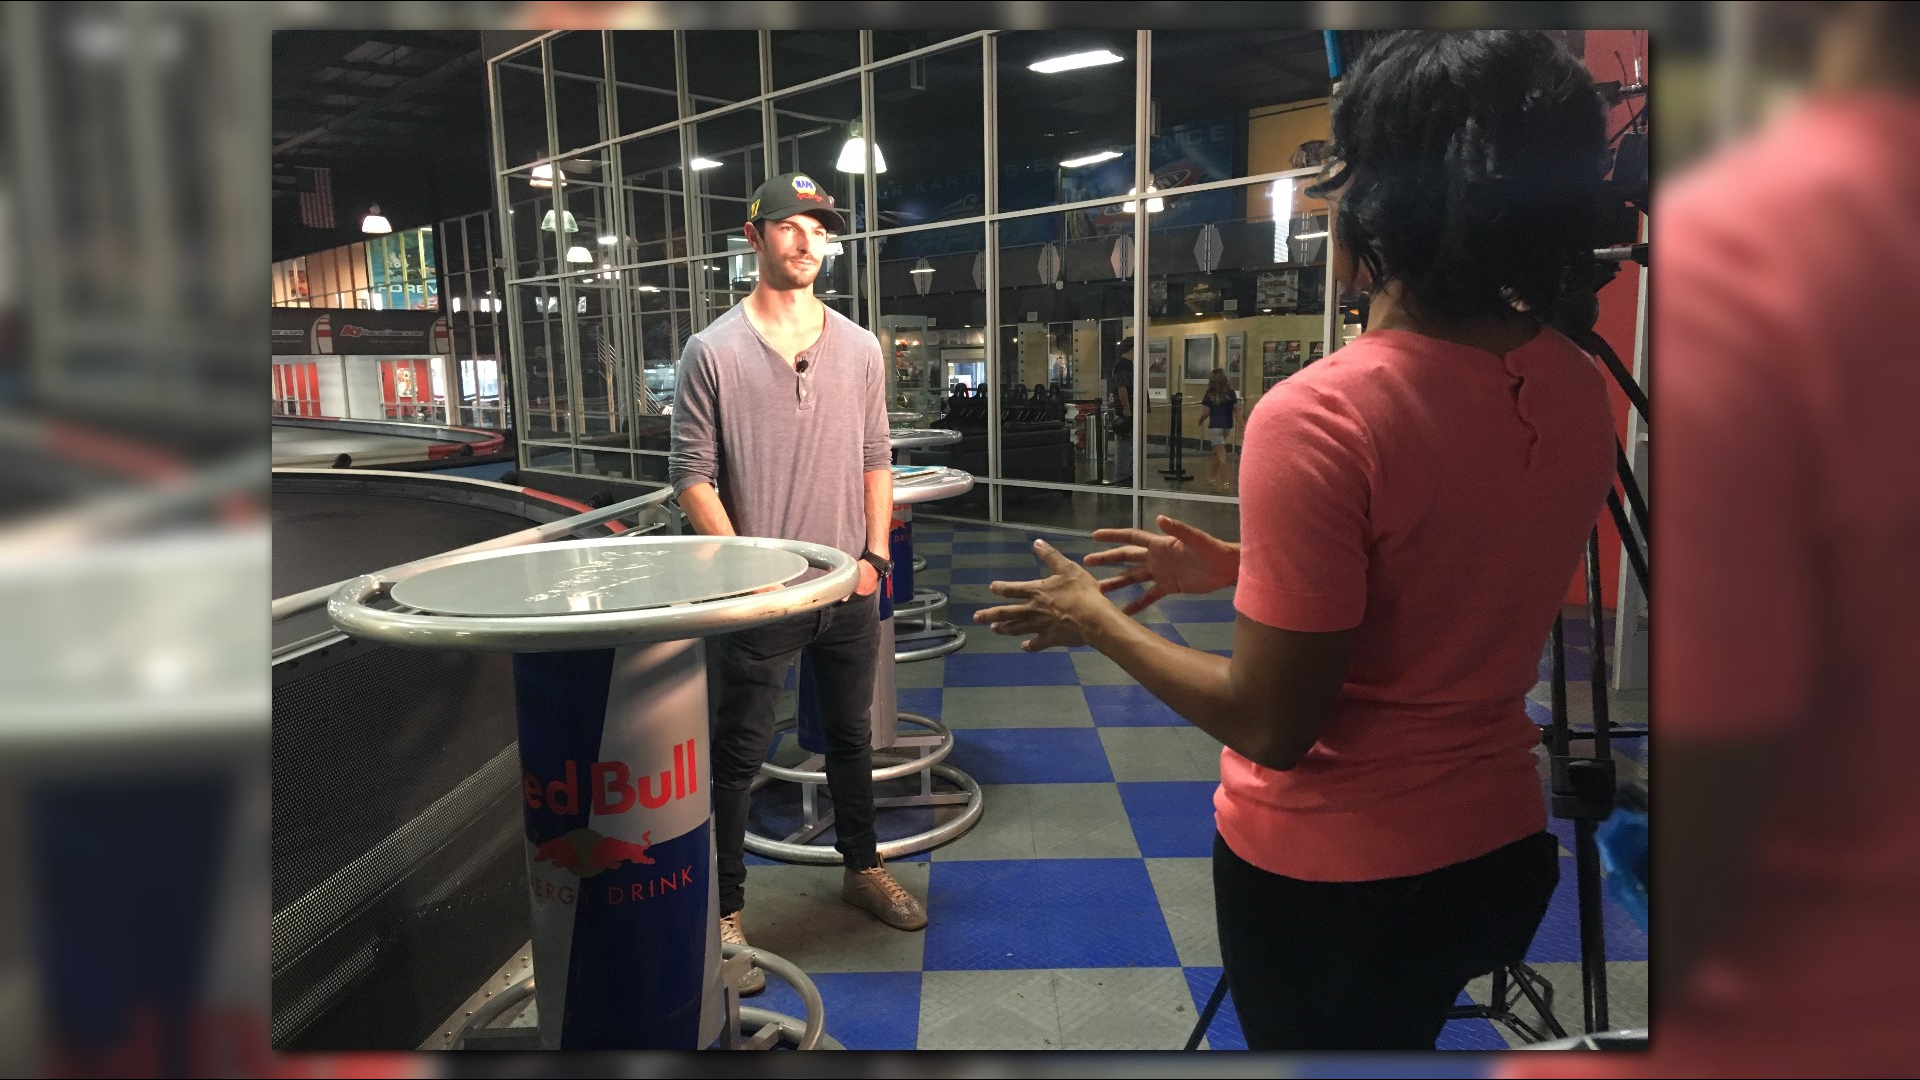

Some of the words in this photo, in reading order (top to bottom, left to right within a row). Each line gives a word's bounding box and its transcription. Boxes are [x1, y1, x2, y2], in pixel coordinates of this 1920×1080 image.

[914, 162, 1016, 194] KARTIG
[590, 737, 697, 816] Bull
[608, 865, 694, 906] DRINK
